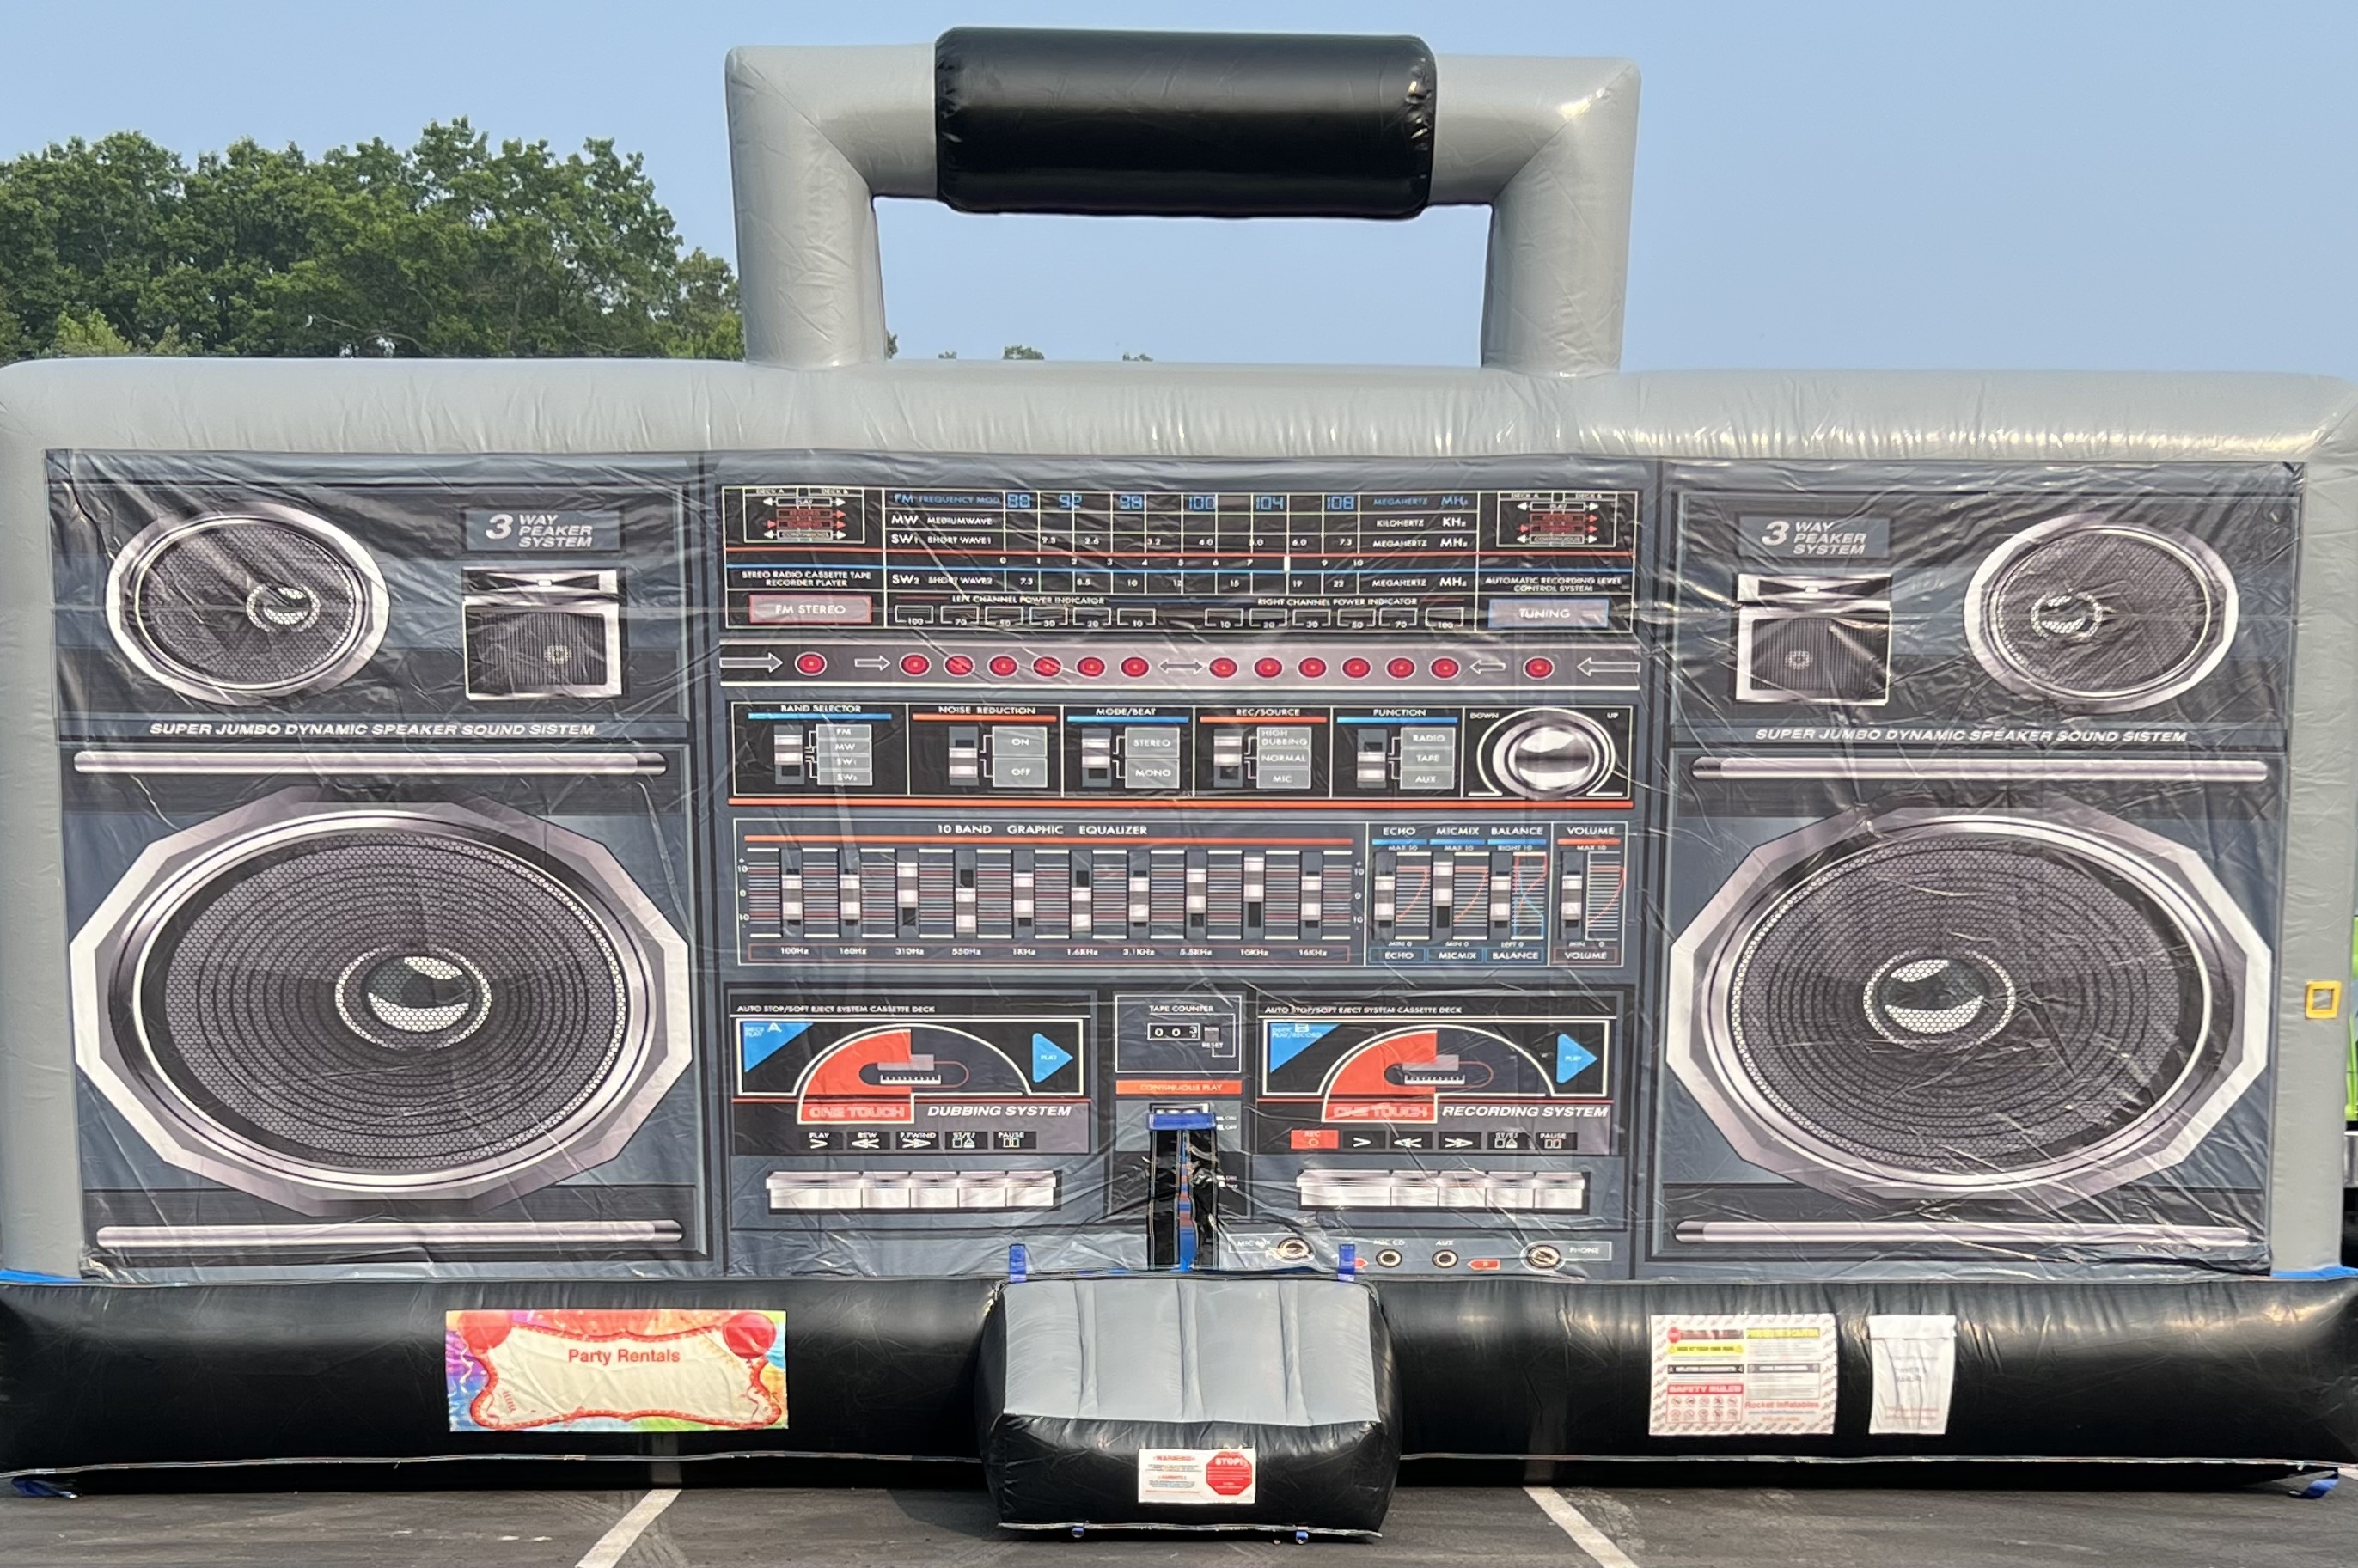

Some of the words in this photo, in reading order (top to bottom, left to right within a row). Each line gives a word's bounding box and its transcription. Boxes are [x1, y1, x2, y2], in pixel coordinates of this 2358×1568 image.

[894, 494, 913, 503] FM
[1189, 496, 1215, 509] 100
[1256, 497, 1284, 509] 104
[1327, 497, 1354, 509] 108
[891, 515, 919, 524] MW
[485, 514, 512, 540] 3
[518, 515, 558, 526] WAY
[518, 526, 593, 537] PEAKER
[1761, 521, 1790, 546] 3
[1794, 522, 1834, 533] WAY
[1793, 533, 1866, 544] PEAKER
[518, 537, 593, 548] SYSTEM
[1793, 544, 1866, 555] SYSTEM
[775, 605, 793, 614] FM
[798, 605, 846, 614] STEREO
[1519, 609, 1570, 618] TUNING
[149, 723, 212, 735] SUPER
[215, 723, 280, 736] JUMBO
[285, 723, 368, 736] DYNAMIC
[371, 723, 458, 736] SPEAKER
[461, 723, 526, 736] SOUND
[528, 723, 596, 736] SISTEM
[1754, 729, 1816, 741] SUPER
[1818, 729, 1881, 741] JUMBO
[1885, 729, 1966, 741] DYNAMIC
[1969, 729, 2053, 742] SPEAKER
[2056, 729, 2119, 742] SOUND
[2122, 730, 2187, 743] SISTEM
[1415, 775, 1436, 784] AUX
[938, 825, 952, 833] 10
[956, 825, 992, 833] BAND
[1007, 825, 1064, 834] GRAPHIC
[1079, 826, 1147, 835] EQUALIZER
[767, 1022, 781, 1032] A
[1155, 1028, 1163, 1036] 0
[1171, 1028, 1180, 1036] 0
[809, 1107, 845, 1117] ONE
[850, 1107, 905, 1117] TOUCH
[927, 1107, 1001, 1116] DUBBING
[1005, 1107, 1072, 1116] SYSTEM
[1373, 1107, 1428, 1118] TOUCH
[1442, 1107, 1538, 1117] RECORDING
[1542, 1107, 1608, 1118] SYSTEM
[569, 1349, 611, 1366] Party
[618, 1349, 681, 1364] Rentals
